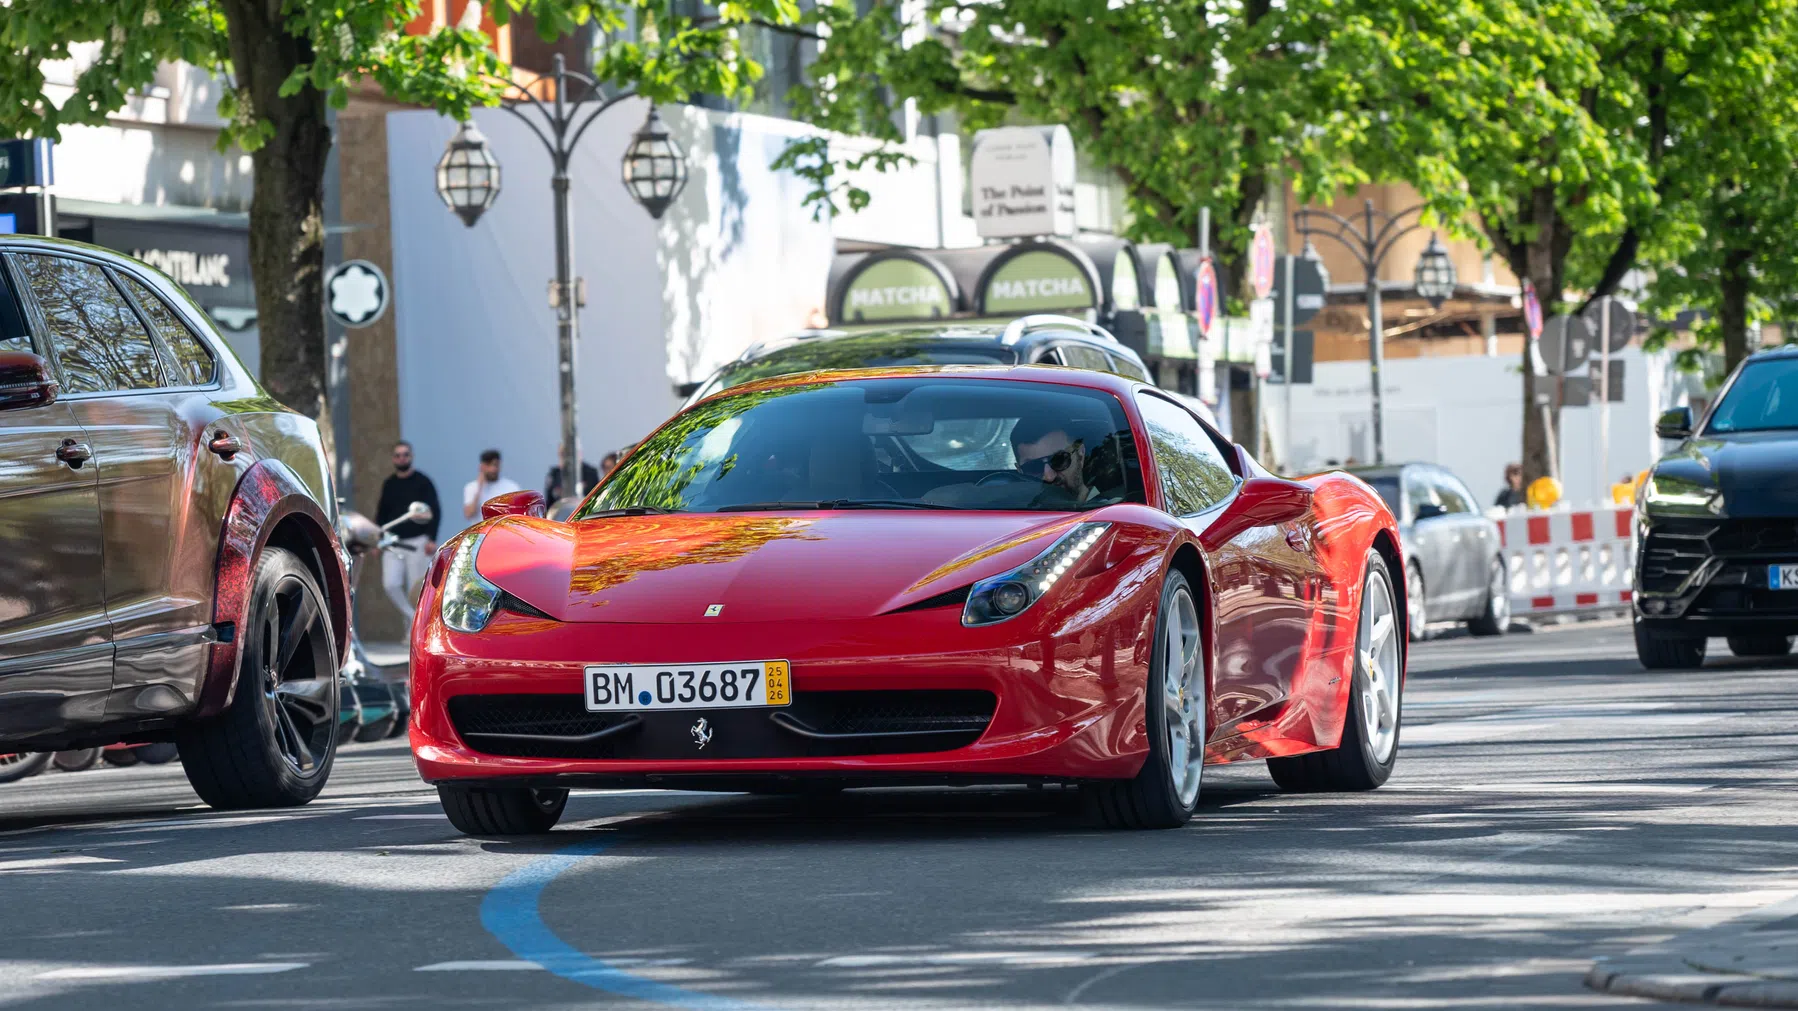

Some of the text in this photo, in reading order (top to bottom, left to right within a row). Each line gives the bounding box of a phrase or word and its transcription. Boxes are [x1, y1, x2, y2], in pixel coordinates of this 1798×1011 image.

[991, 277, 1085, 299] MATCHA
[851, 286, 942, 308] MATCHA
[768, 666, 783, 677] 25
[592, 668, 760, 705] BM 03687
[768, 678, 783, 688] 04
[769, 690, 784, 700] 26
